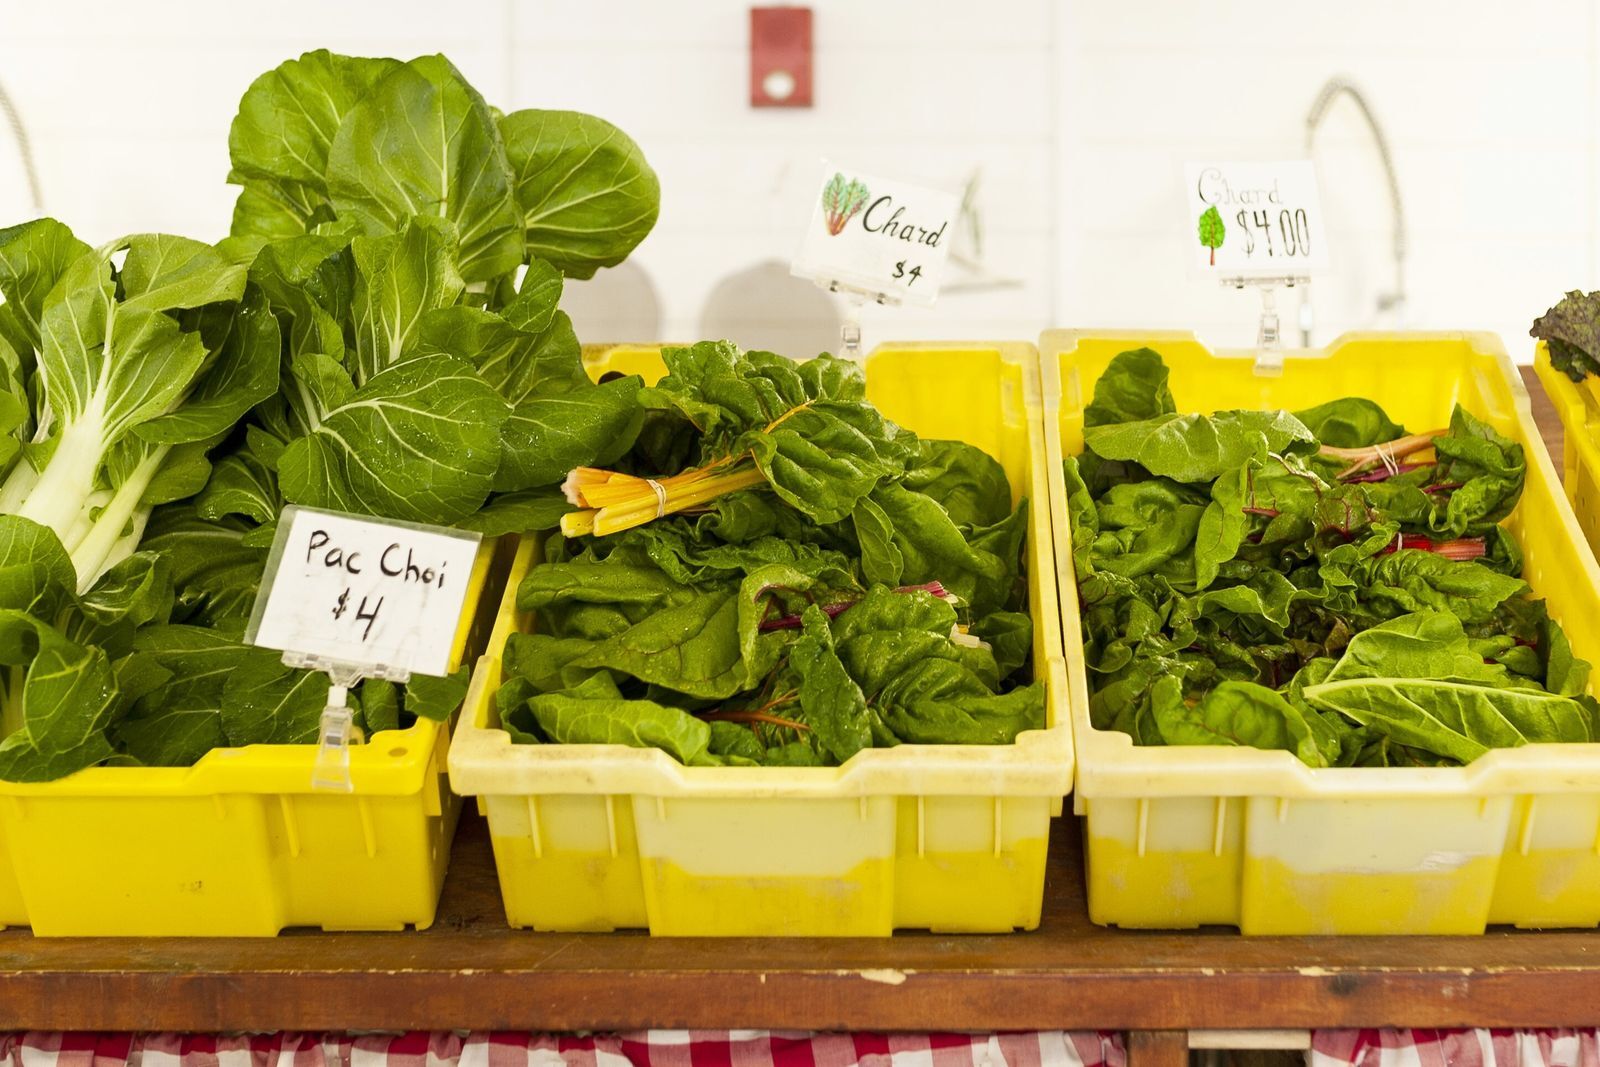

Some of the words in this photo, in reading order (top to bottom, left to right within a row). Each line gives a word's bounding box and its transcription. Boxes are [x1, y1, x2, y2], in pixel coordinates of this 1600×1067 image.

[1198, 167, 1283, 205] Chard
[862, 195, 948, 248] Chard
[1236, 208, 1310, 258] $4.00
[892, 259, 922, 286] $4
[306, 529, 362, 575] Pac
[380, 542, 448, 589] Choi
